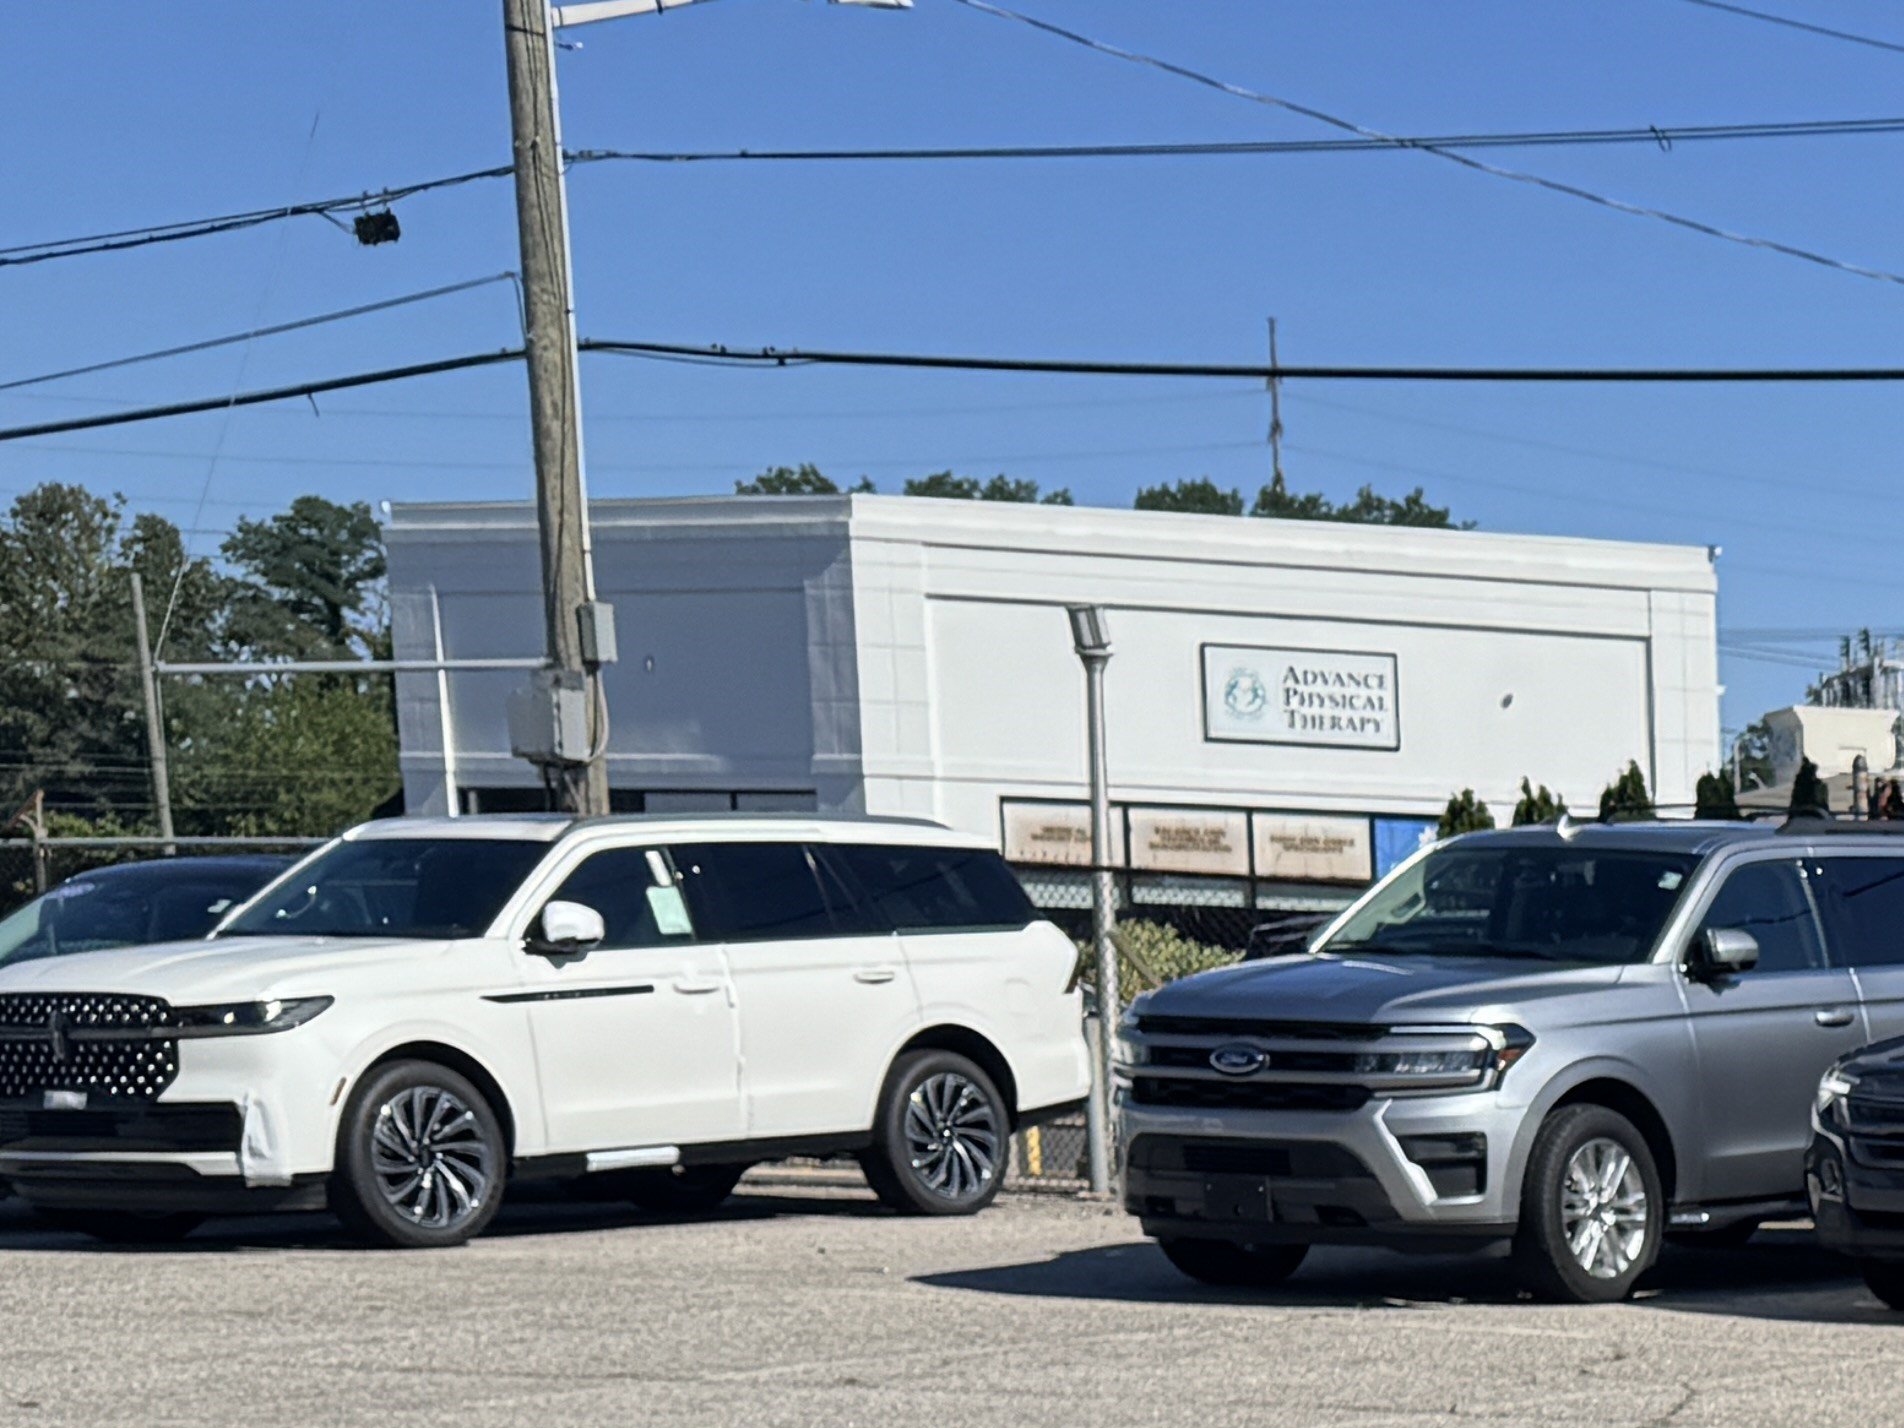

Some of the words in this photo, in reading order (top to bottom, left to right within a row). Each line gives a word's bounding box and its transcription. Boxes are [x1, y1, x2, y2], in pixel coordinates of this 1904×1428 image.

[1283, 666, 1386, 691] ADVANCE
[1283, 687, 1388, 713] PHYSICAL
[1283, 709, 1382, 734] THERAPY
